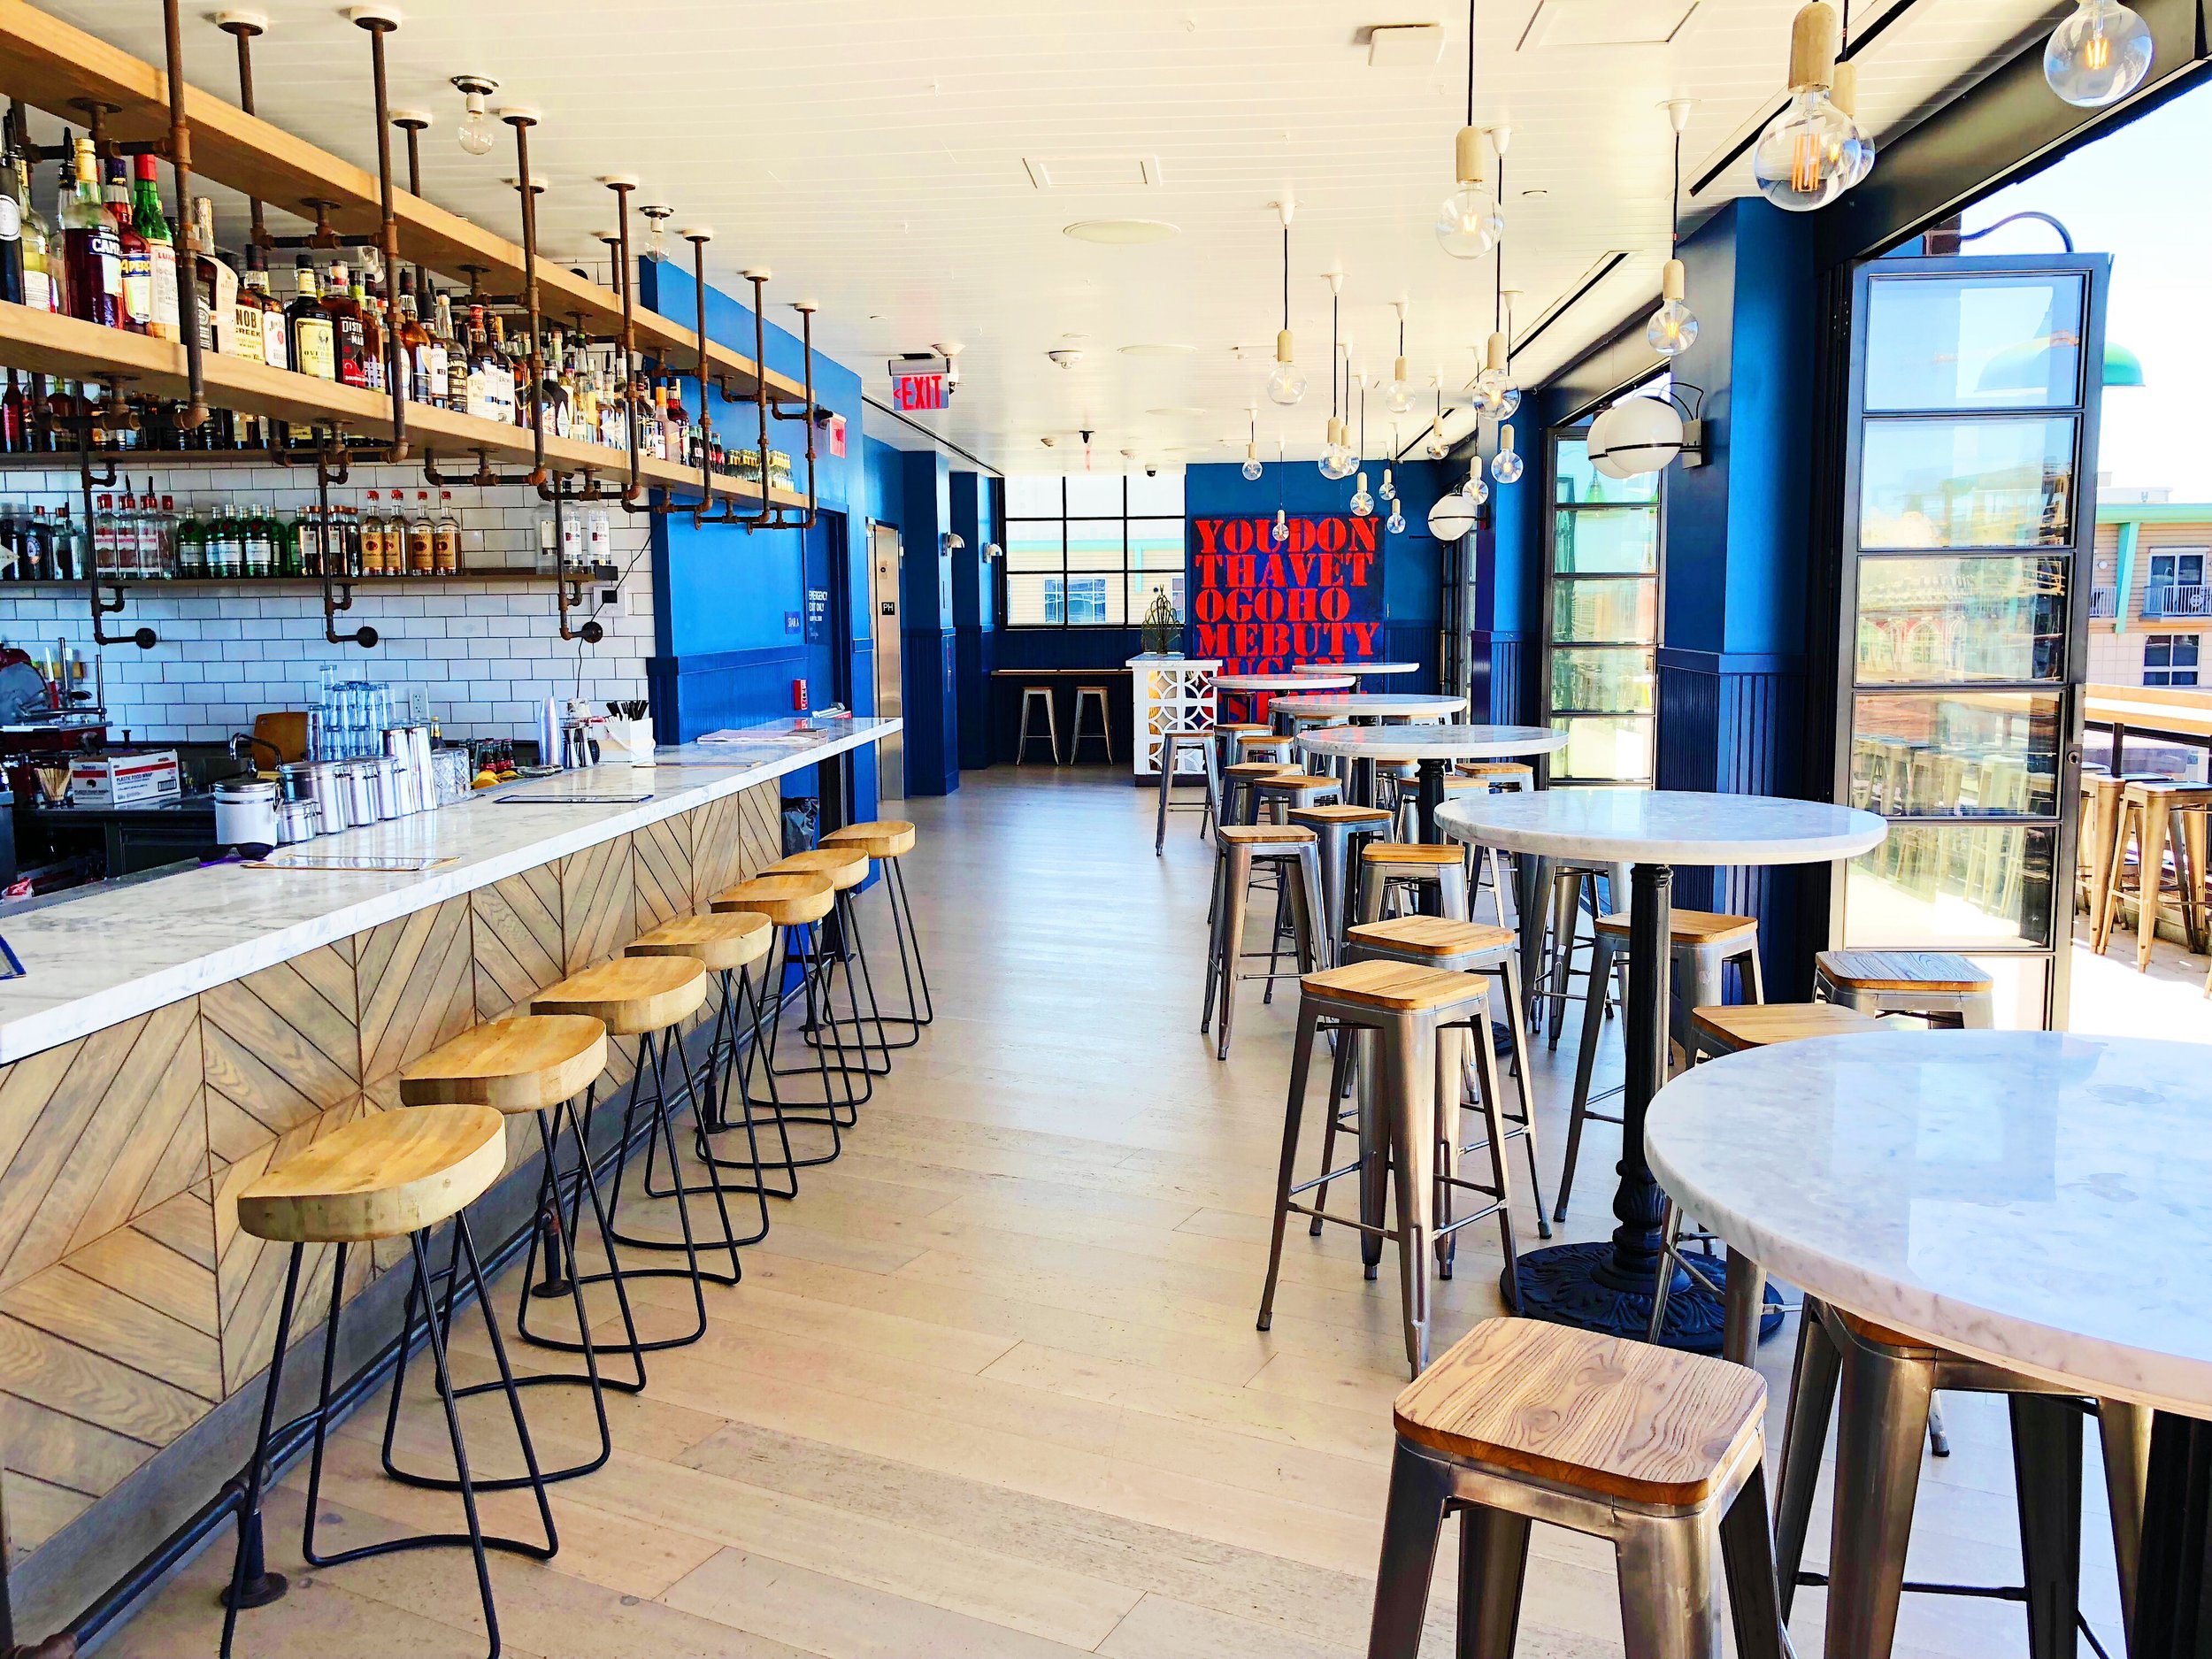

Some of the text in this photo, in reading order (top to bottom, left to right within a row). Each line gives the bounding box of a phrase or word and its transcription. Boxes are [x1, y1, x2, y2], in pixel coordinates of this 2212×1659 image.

[235, 308, 257, 329] NOB
[901, 376, 942, 411] EXIT
[1194, 518, 1379, 554] YOUDON
[1195, 552, 1373, 588] THAVET
[809, 590, 828, 602] EMERGENCY
[882, 603, 894, 612] PH
[1195, 588, 1350, 623] OGOHO
[1196, 622, 1380, 657] MEBUTY
